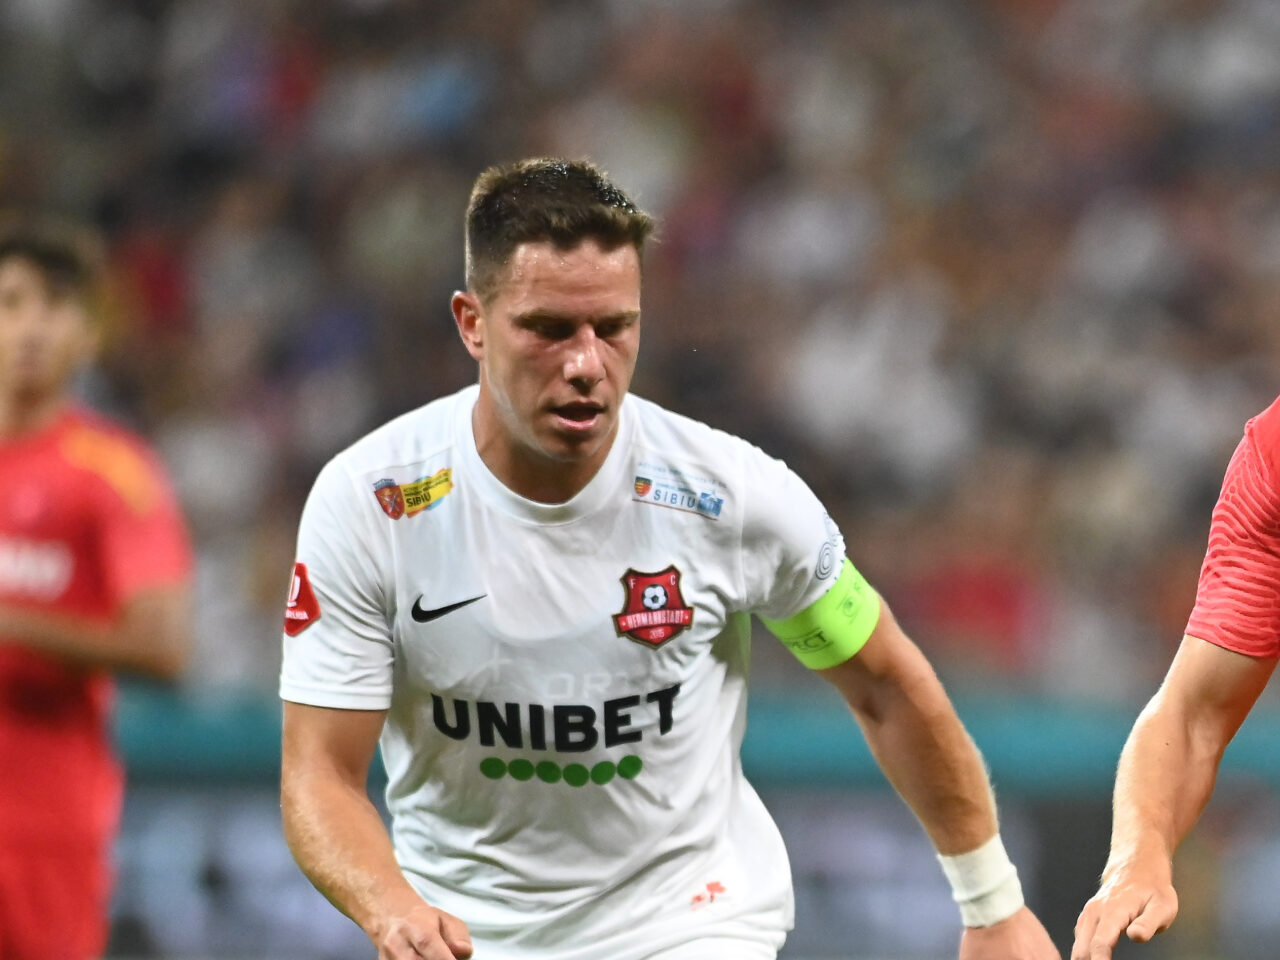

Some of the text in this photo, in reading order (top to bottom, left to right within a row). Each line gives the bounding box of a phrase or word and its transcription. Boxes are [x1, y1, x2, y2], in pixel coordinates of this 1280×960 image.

[405, 492, 432, 508] SIBIU
[653, 489, 697, 509] SIBIU
[430, 683, 681, 752] UNIBET
